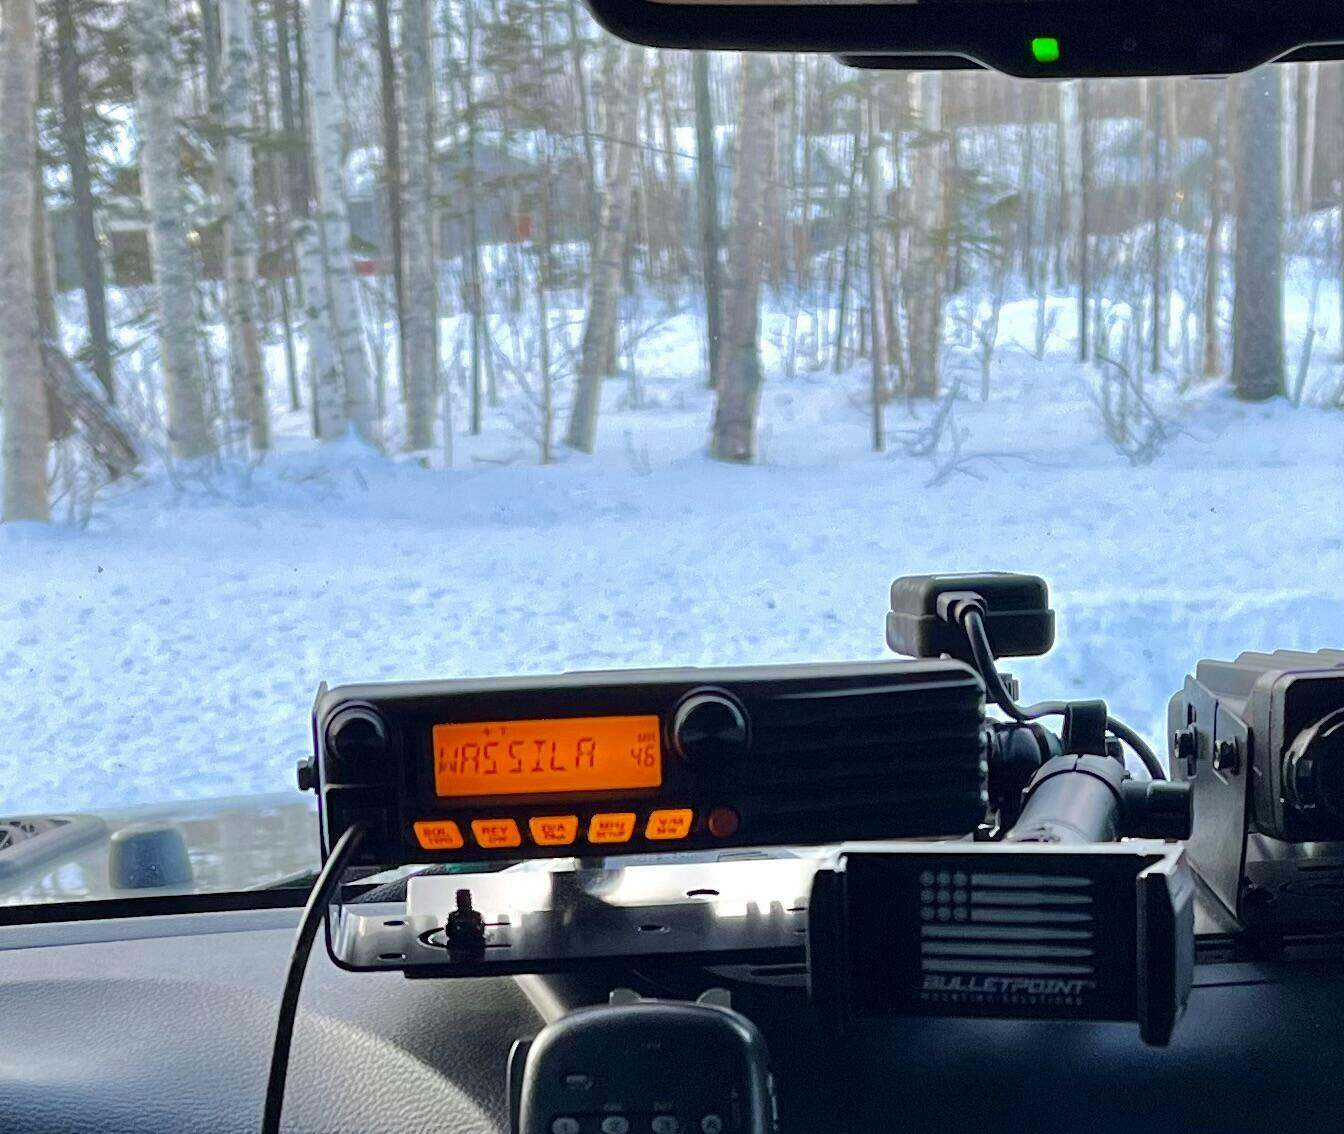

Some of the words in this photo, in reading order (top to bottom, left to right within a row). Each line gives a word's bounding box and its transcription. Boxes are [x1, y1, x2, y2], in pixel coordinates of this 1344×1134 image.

[439, 737, 596, 775] WASSILA
[630, 745, 656, 768] 46
[921, 973, 1090, 995] BULLETPOINT
